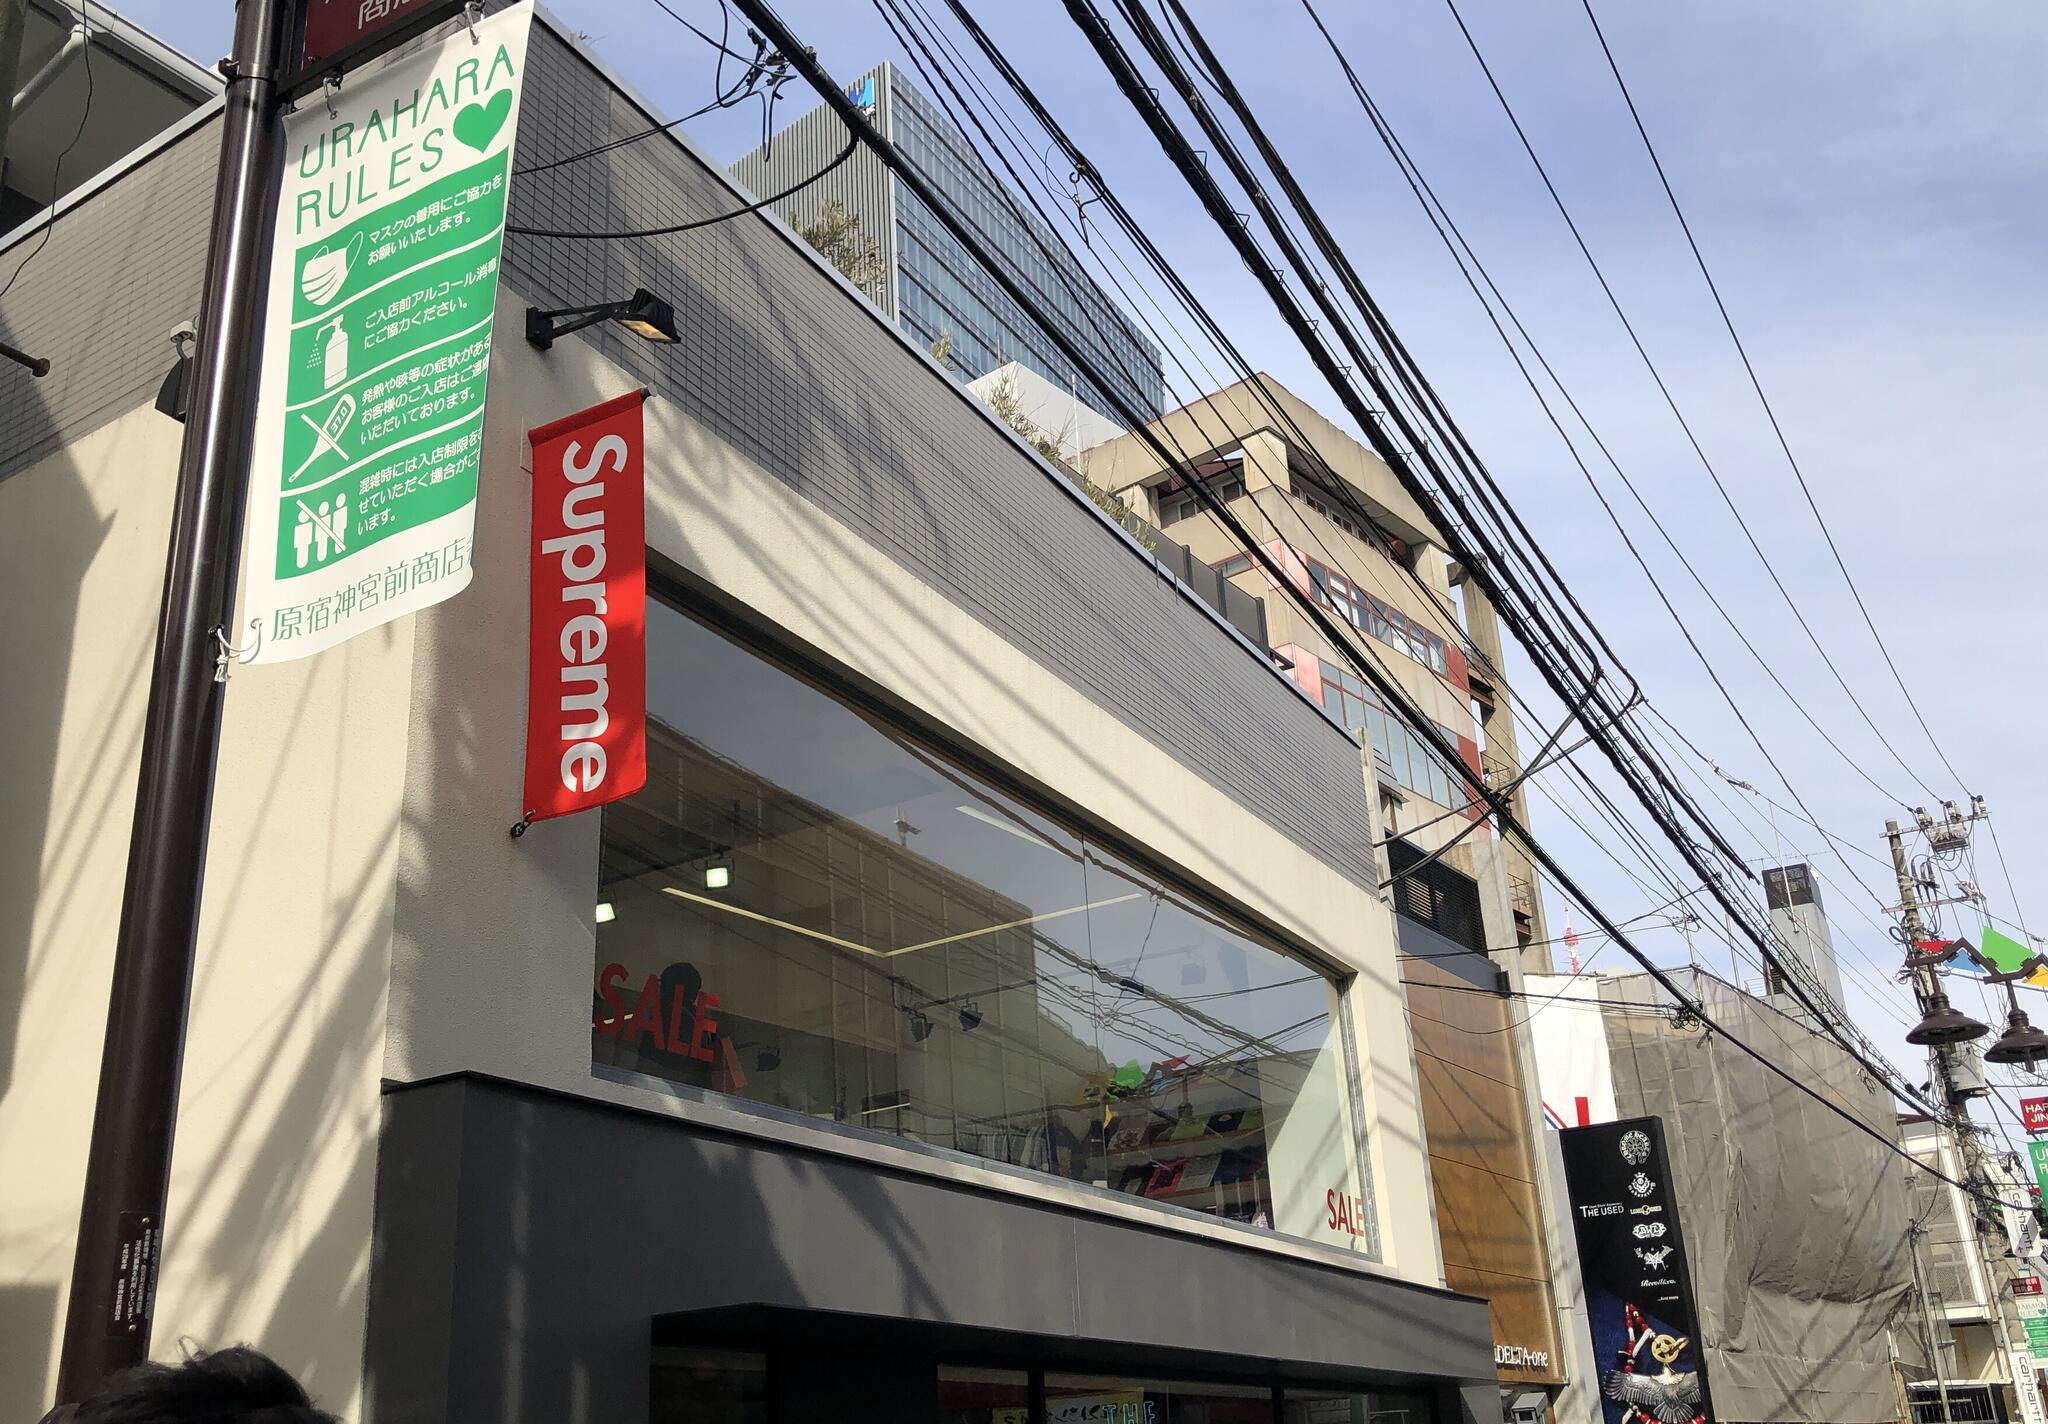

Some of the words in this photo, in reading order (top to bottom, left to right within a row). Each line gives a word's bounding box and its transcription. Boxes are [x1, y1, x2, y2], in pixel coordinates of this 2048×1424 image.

[299, 43, 515, 179] URAHARA
[296, 127, 444, 236] RULES
[368, 172, 503, 244] マスクの着用にご協力を
[367, 210, 471, 266] お願いいたします。
[364, 296, 468, 350] にご協力ください。
[331, 406, 348, 433] 37.0
[360, 386, 475, 445] いただいております。
[358, 449, 480, 514] せていただく場合がご
[358, 508, 396, 535] います。
[542, 434, 629, 794] Supreme
[594, 962, 720, 1062] SALE
[2035, 1149, 2048, 1161] U
[1327, 1188, 1364, 1237] SALE
[1579, 1205, 1600, 1218] THE
[1600, 1205, 1624, 1216] USED
